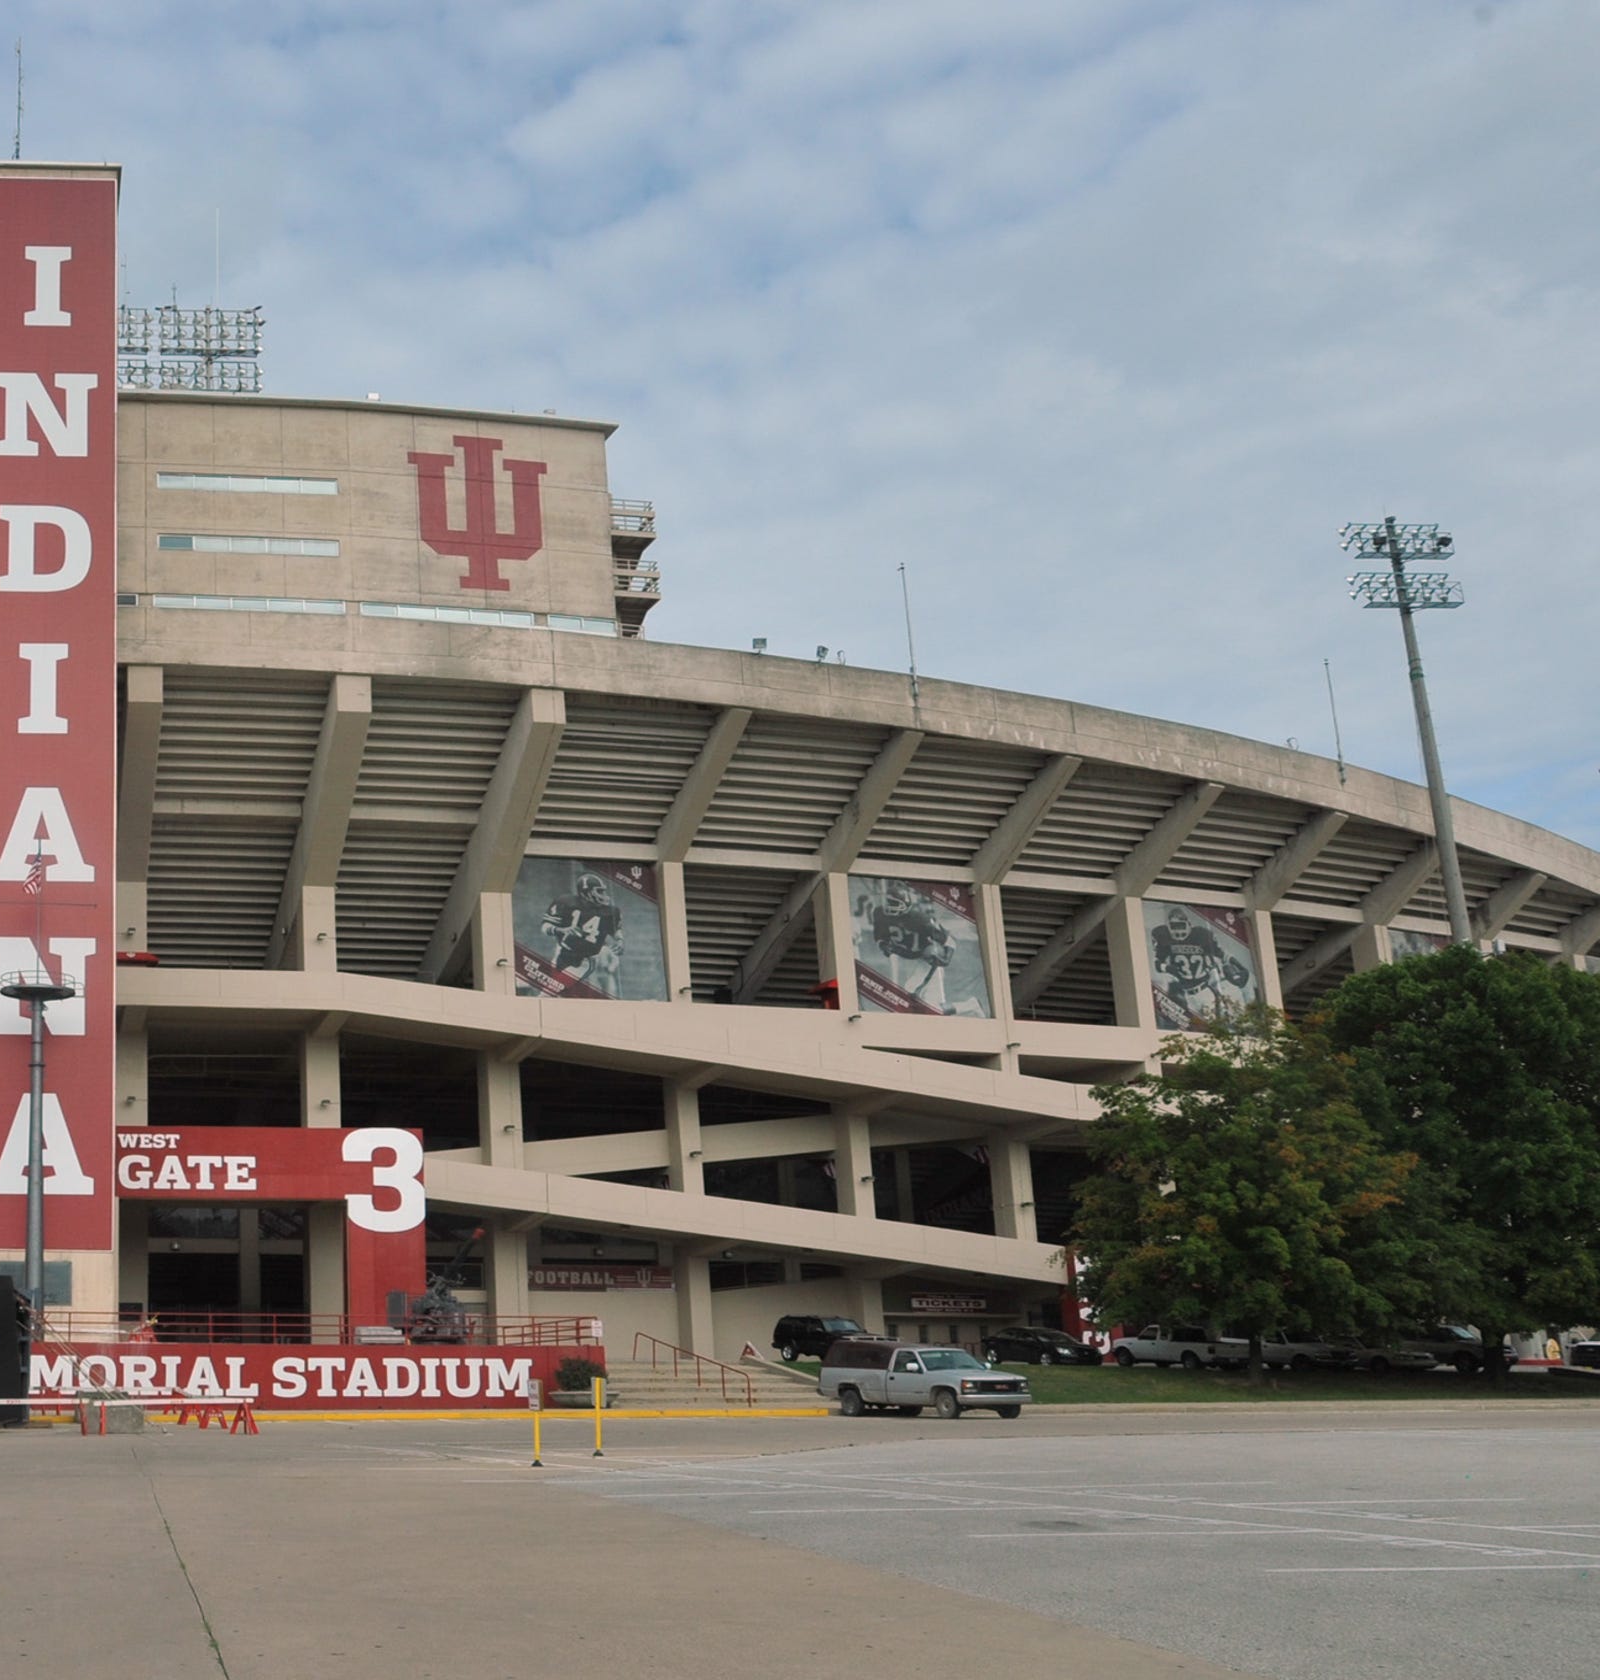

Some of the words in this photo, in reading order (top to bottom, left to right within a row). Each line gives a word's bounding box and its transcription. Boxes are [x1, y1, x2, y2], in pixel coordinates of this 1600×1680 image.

[563, 908, 601, 944] 14
[1174, 954, 1207, 980] 32
[117, 1133, 180, 1149] WEST
[118, 1154, 257, 1190] GATE
[342, 1127, 426, 1233] 3
[918, 1299, 983, 1308] TICKETS
[272, 1357, 533, 1398] STADIUM
